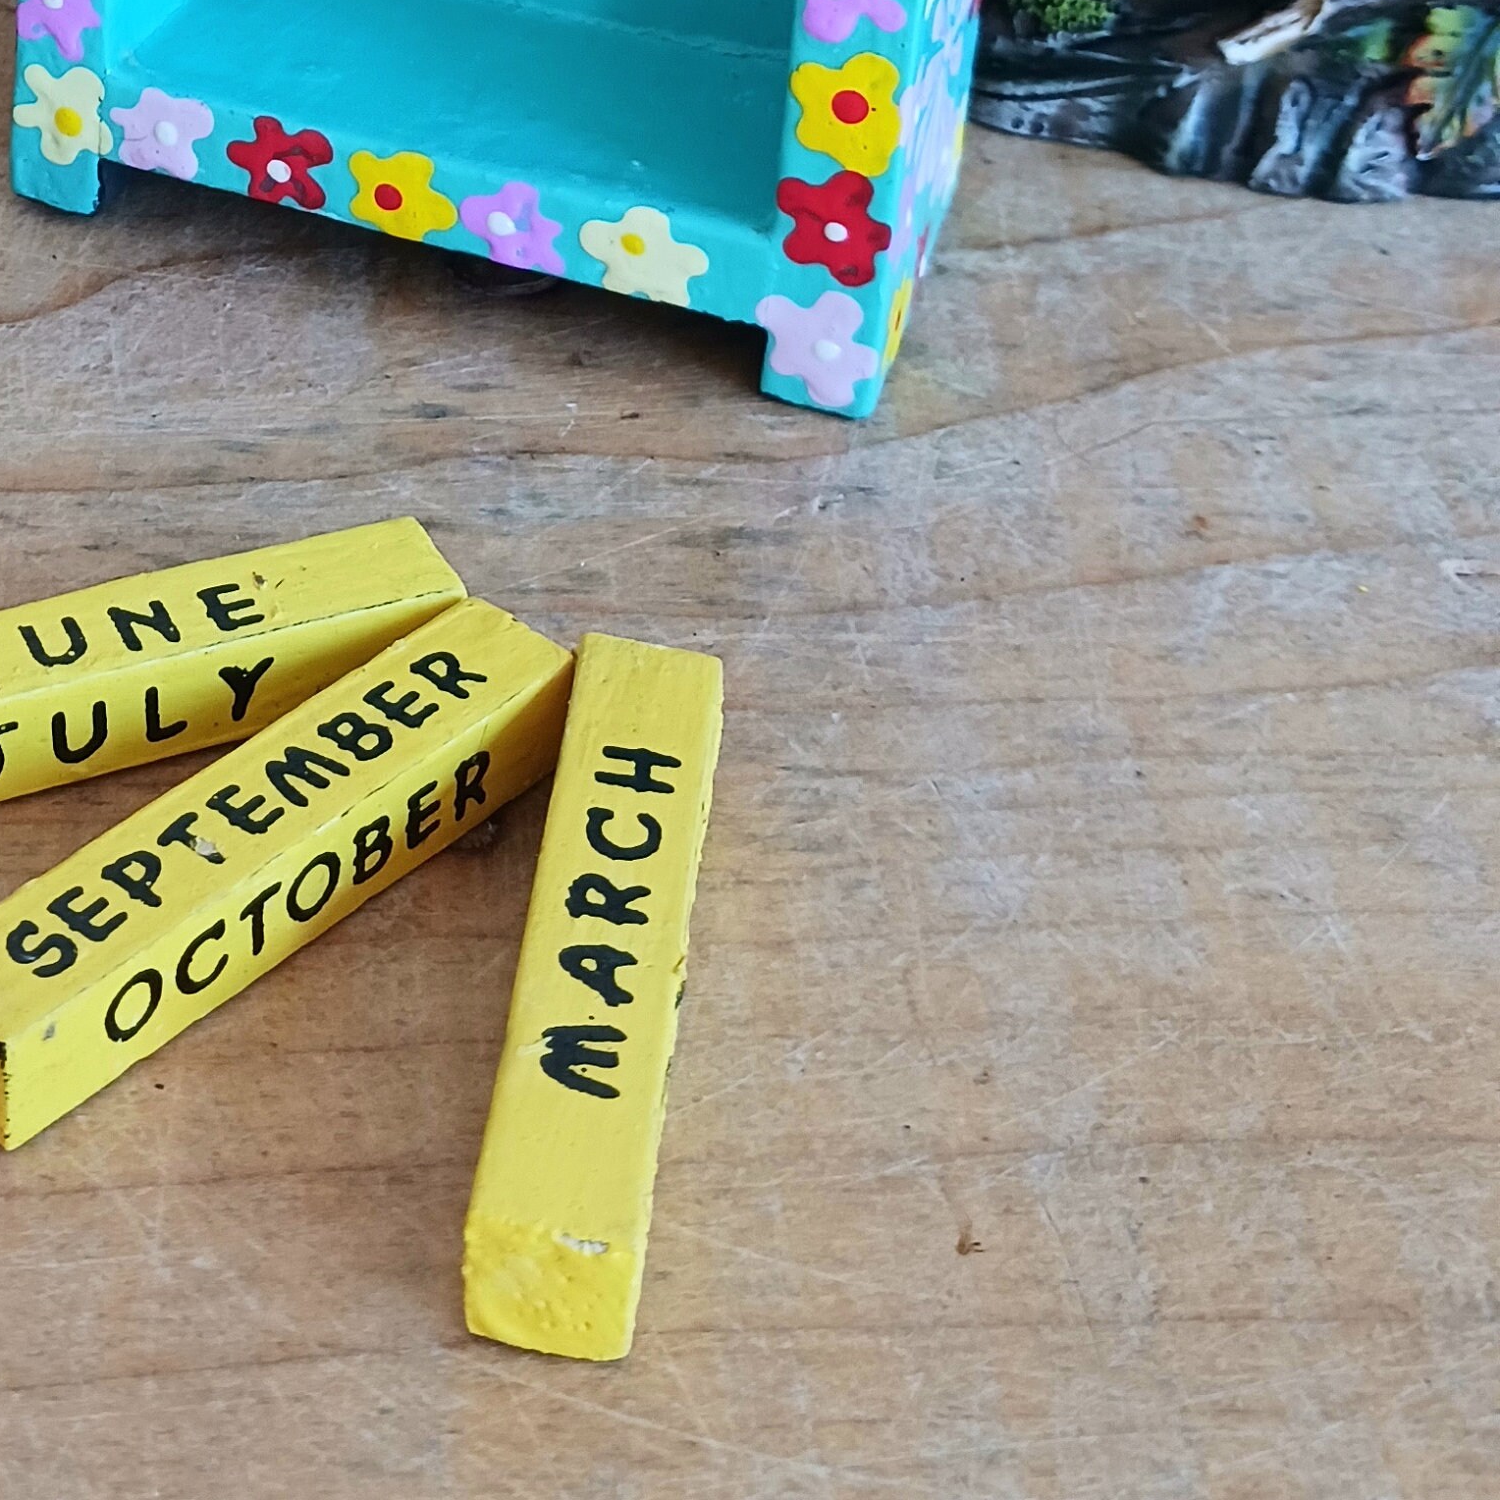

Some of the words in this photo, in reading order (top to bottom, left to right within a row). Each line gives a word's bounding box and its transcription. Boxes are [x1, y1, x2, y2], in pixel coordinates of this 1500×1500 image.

[5, 650, 488, 978] SEPTEMBER
[104, 750, 492, 1043] OCTOBER
[539, 745, 682, 1099] MARCH
